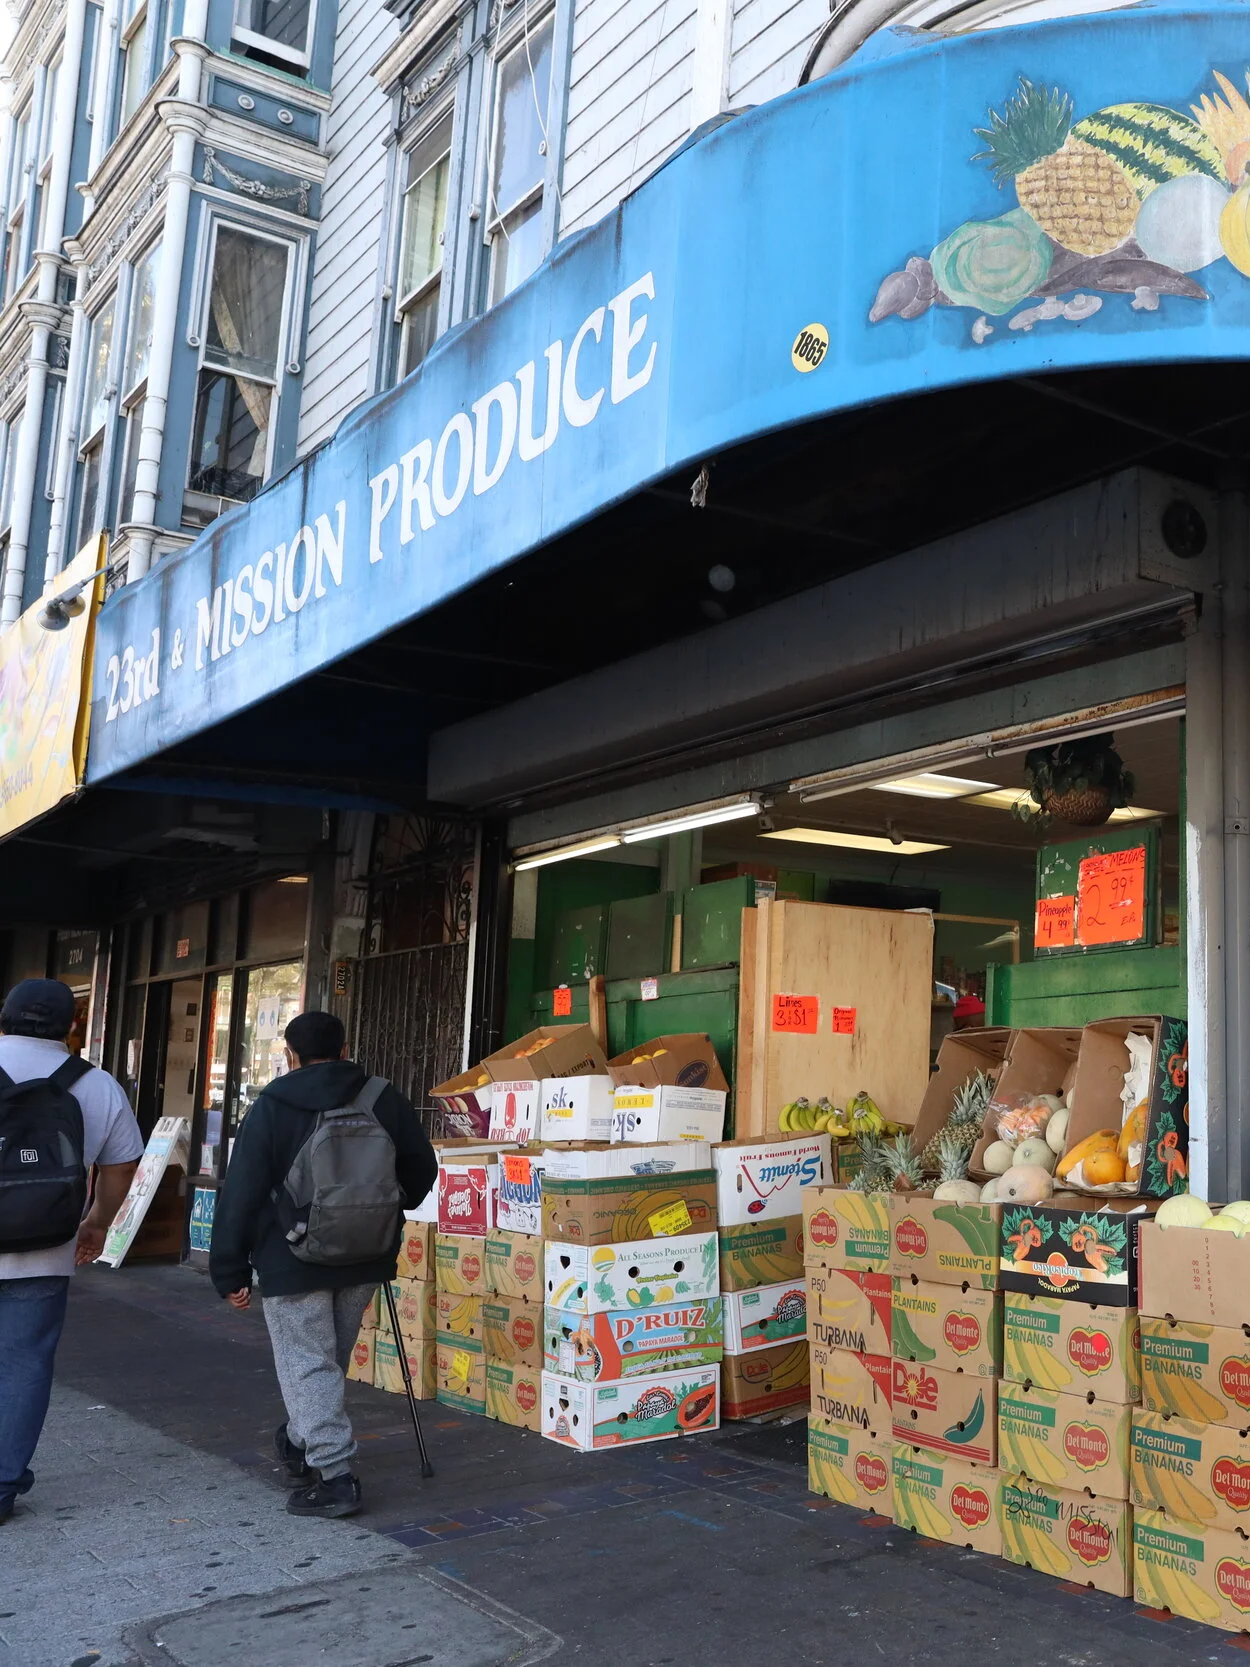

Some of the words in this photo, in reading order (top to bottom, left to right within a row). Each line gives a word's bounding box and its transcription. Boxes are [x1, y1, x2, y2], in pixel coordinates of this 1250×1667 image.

[794, 331, 827, 366] 1865
[105, 628, 160, 723] 23rd
[171, 633, 184, 671] &
[195, 501, 345, 672] MISSION
[368, 271, 657, 564] PRODUCE
[1039, 901, 1072, 917] Pineapple
[1087, 884, 1106, 926] 2
[1043, 921, 1052, 939] 4
[552, 1086, 568, 1108] sk
[615, 1112, 636, 1140] sk
[759, 1154, 821, 1186] Stemilt
[731, 1234, 774, 1247] Premium
[849, 1227, 889, 1242] BANANAS
[632, 1250, 664, 1261] SEASONS
[664, 1245, 698, 1257] PRODUCE
[732, 1244, 782, 1261] BANANAS
[855, 1243, 889, 1258] Premium
[939, 1254, 992, 1271] PLANTAINS
[811, 1277, 826, 1293] P50
[863, 1286, 892, 1299] Plantains
[893, 1293, 937, 1314] PLANTAINS
[1007, 1310, 1047, 1329] Premium
[638, 1337, 660, 1348] PAPAYA
[659, 1333, 684, 1345] MARADOL
[813, 1322, 867, 1352] TURBANA
[1007, 1328, 1054, 1348] BANANAS
[1071, 1339, 1083, 1353] Del
[814, 1349, 828, 1366] P50
[1144, 1339, 1193, 1359] Premium
[1144, 1358, 1203, 1380] BANANAS
[1223, 1370, 1238, 1385] Del
[893, 1361, 939, 1404] Dole
[635, 1399, 677, 1422] Maradol
[817, 1394, 870, 1427] TURBANA
[1000, 1400, 1042, 1421] Premium
[1000, 1418, 1049, 1441] BANANAS
[809, 1434, 838, 1450] Premium
[1067, 1433, 1080, 1448] Del
[1080, 1436, 1107, 1453] Monte
[1135, 1429, 1186, 1454] Premium
[809, 1447, 844, 1468] BANANAS
[1134, 1449, 1194, 1477] BANANAS
[1215, 1469, 1230, 1485] Del
[1227, 1487, 1249, 1500] Quality
[953, 1494, 965, 1507] Del
[965, 1497, 989, 1514] Monte
[1070, 1527, 1083, 1542] Del
[1083, 1530, 1109, 1549] Monte
[1137, 1527, 1188, 1555] Premium
[1137, 1546, 1197, 1577] BANANAS
[1220, 1570, 1235, 1586] Del
